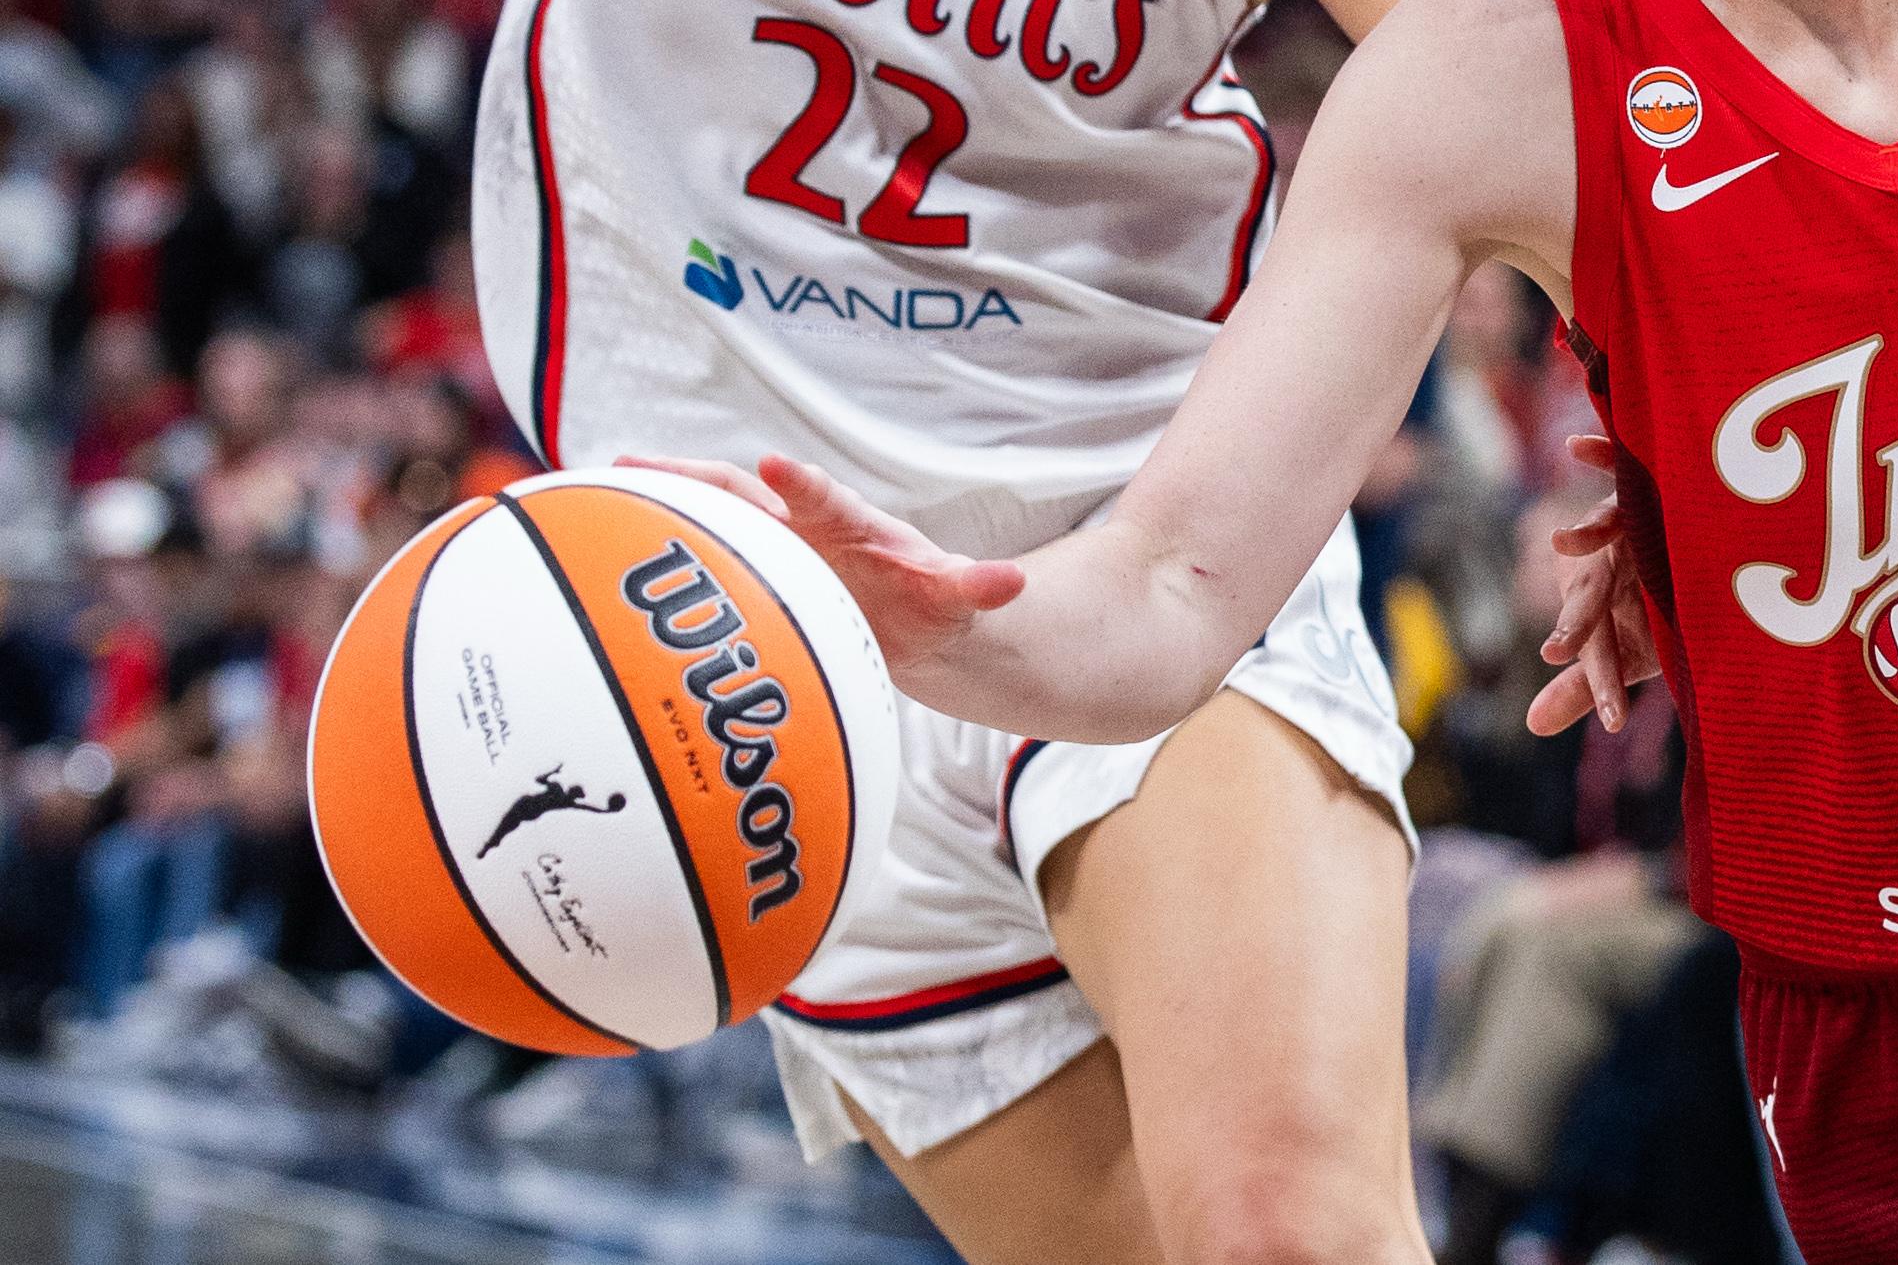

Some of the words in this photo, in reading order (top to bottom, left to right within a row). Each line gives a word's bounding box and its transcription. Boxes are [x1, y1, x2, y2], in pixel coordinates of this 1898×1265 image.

[743, 17, 970, 250] 22
[753, 268, 1022, 330] VANDA
[462, 648, 484, 706] GAME
[477, 711, 500, 766] BALL
[481, 654, 511, 746] OFFICIAL
[620, 538, 804, 923] Wilson
[661, 698, 688, 743] EVO
[685, 749, 710, 793] NXT
